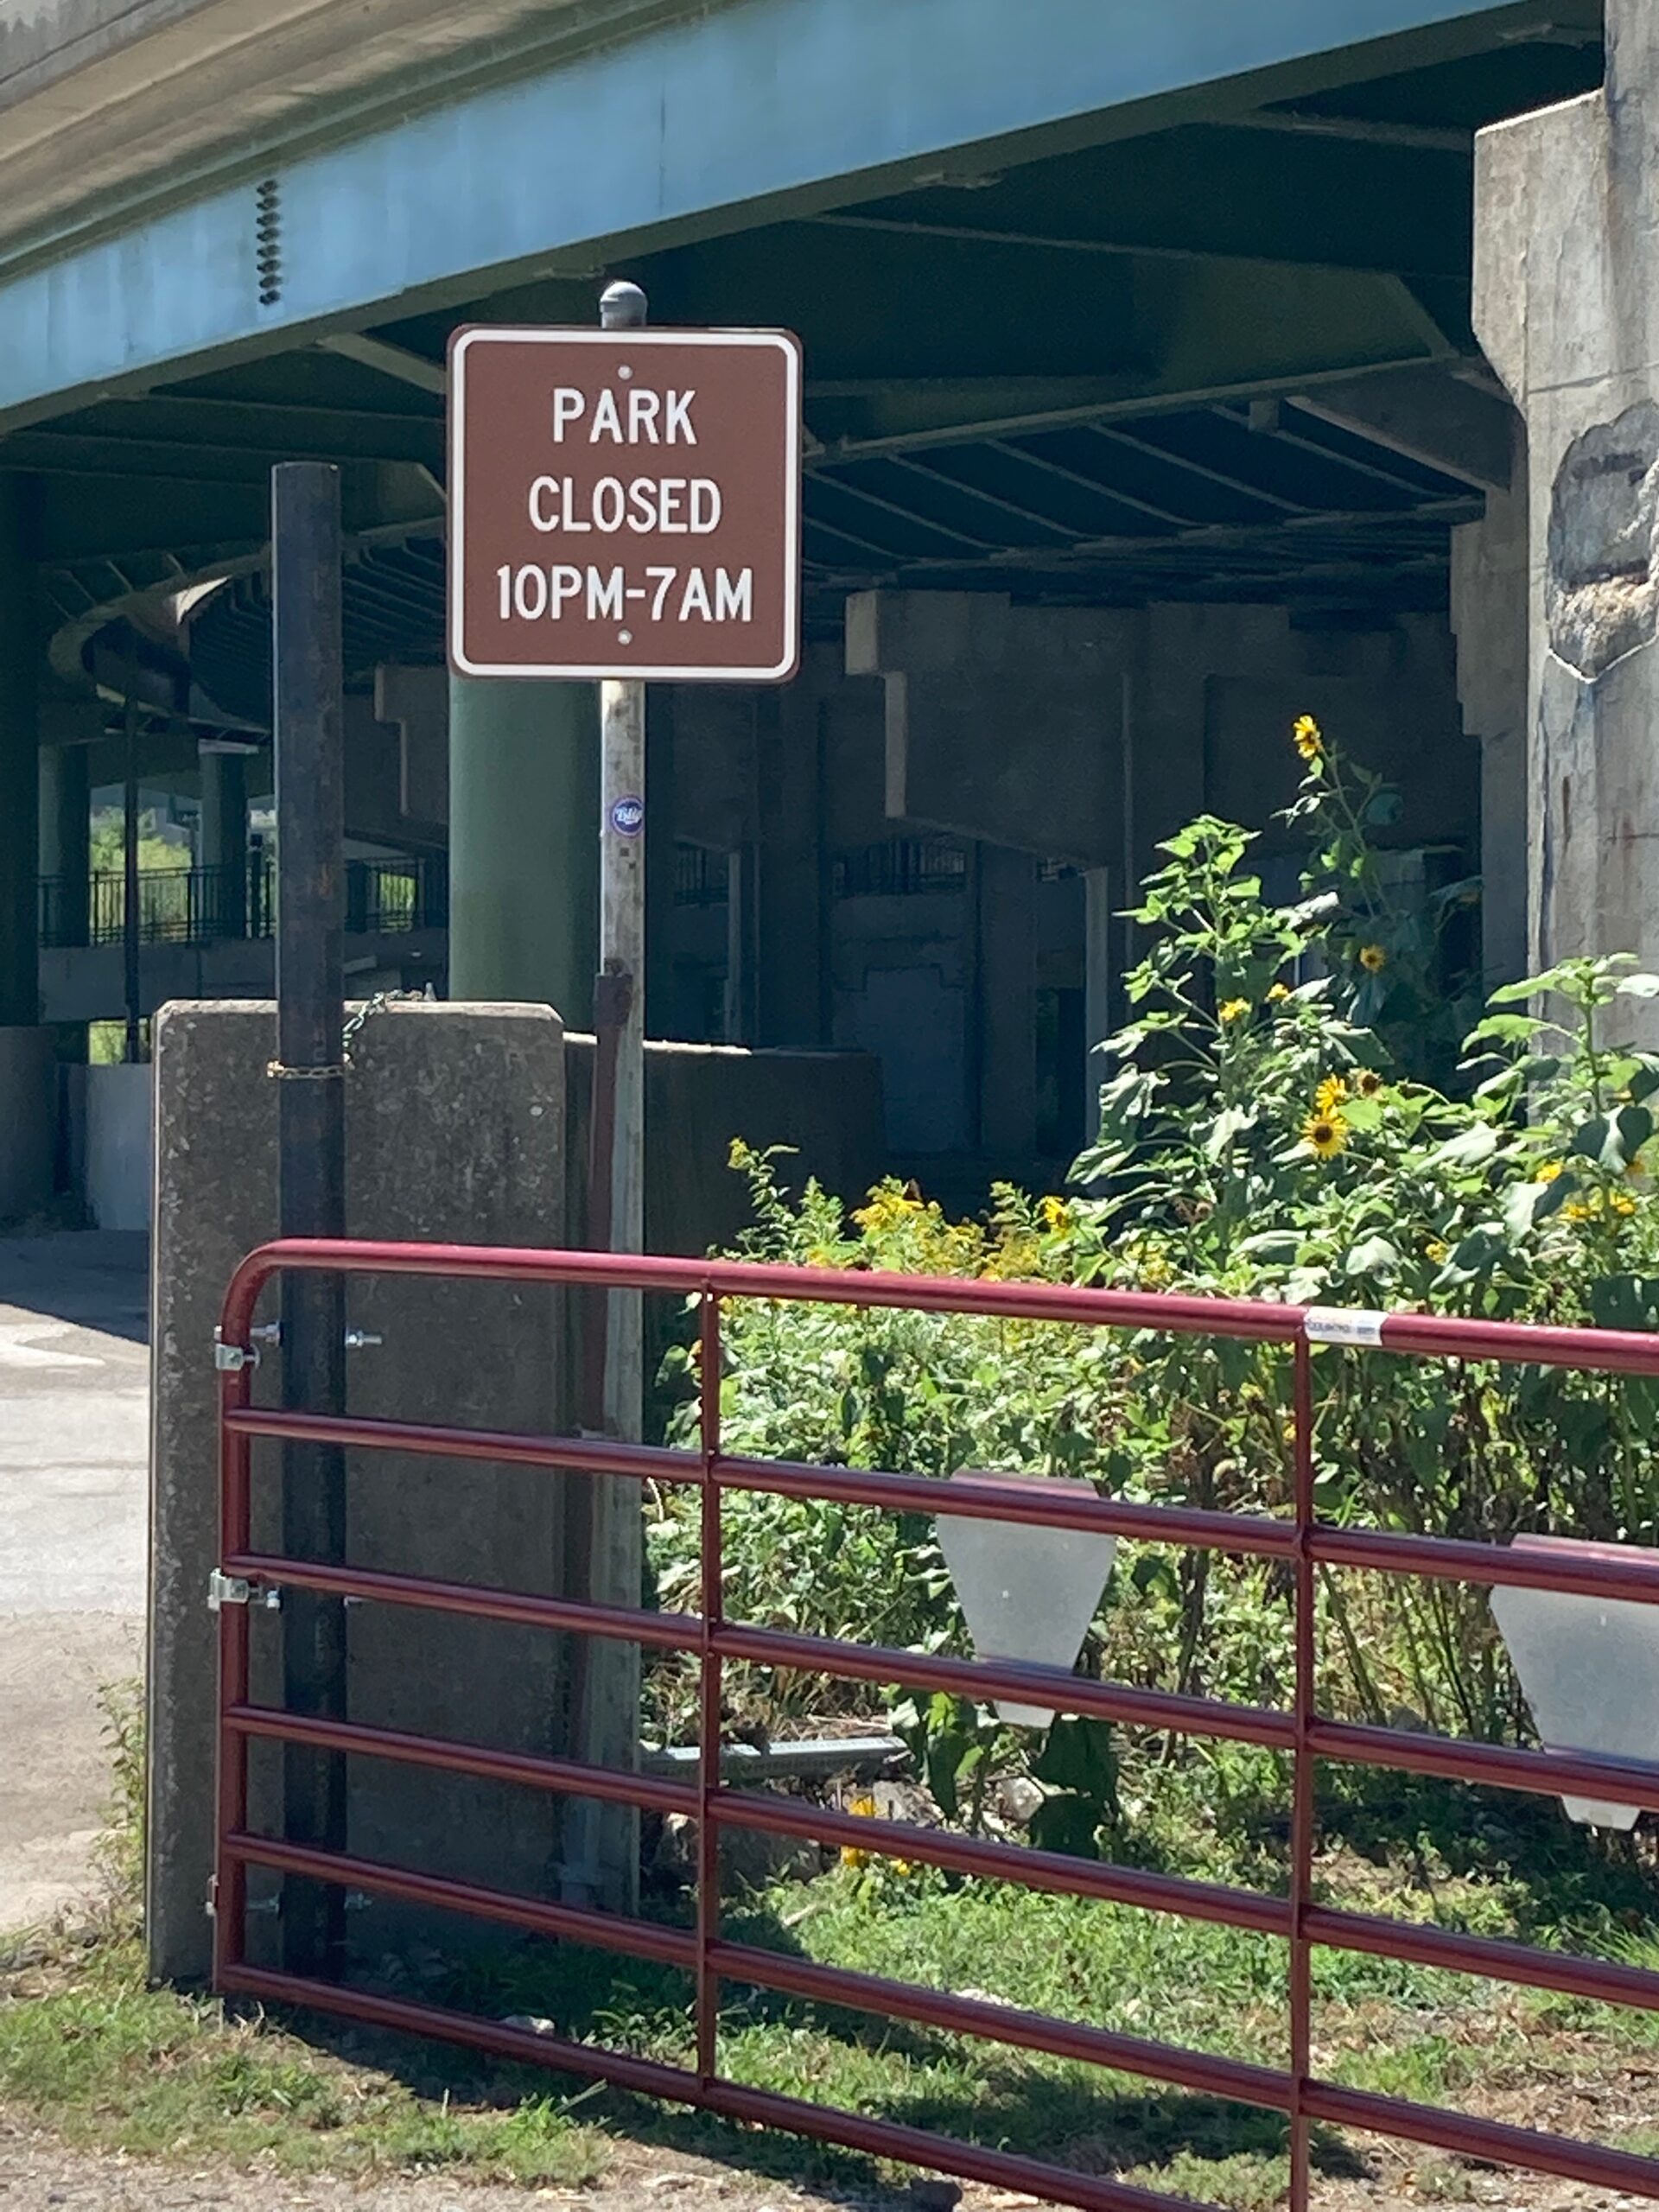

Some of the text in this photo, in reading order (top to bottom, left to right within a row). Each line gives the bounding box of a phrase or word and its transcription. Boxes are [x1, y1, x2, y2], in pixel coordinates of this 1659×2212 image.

[553, 388, 697, 445] PARK
[528, 475, 722, 534] CLOSED
[496, 563, 753, 622] 10PM-7AM
